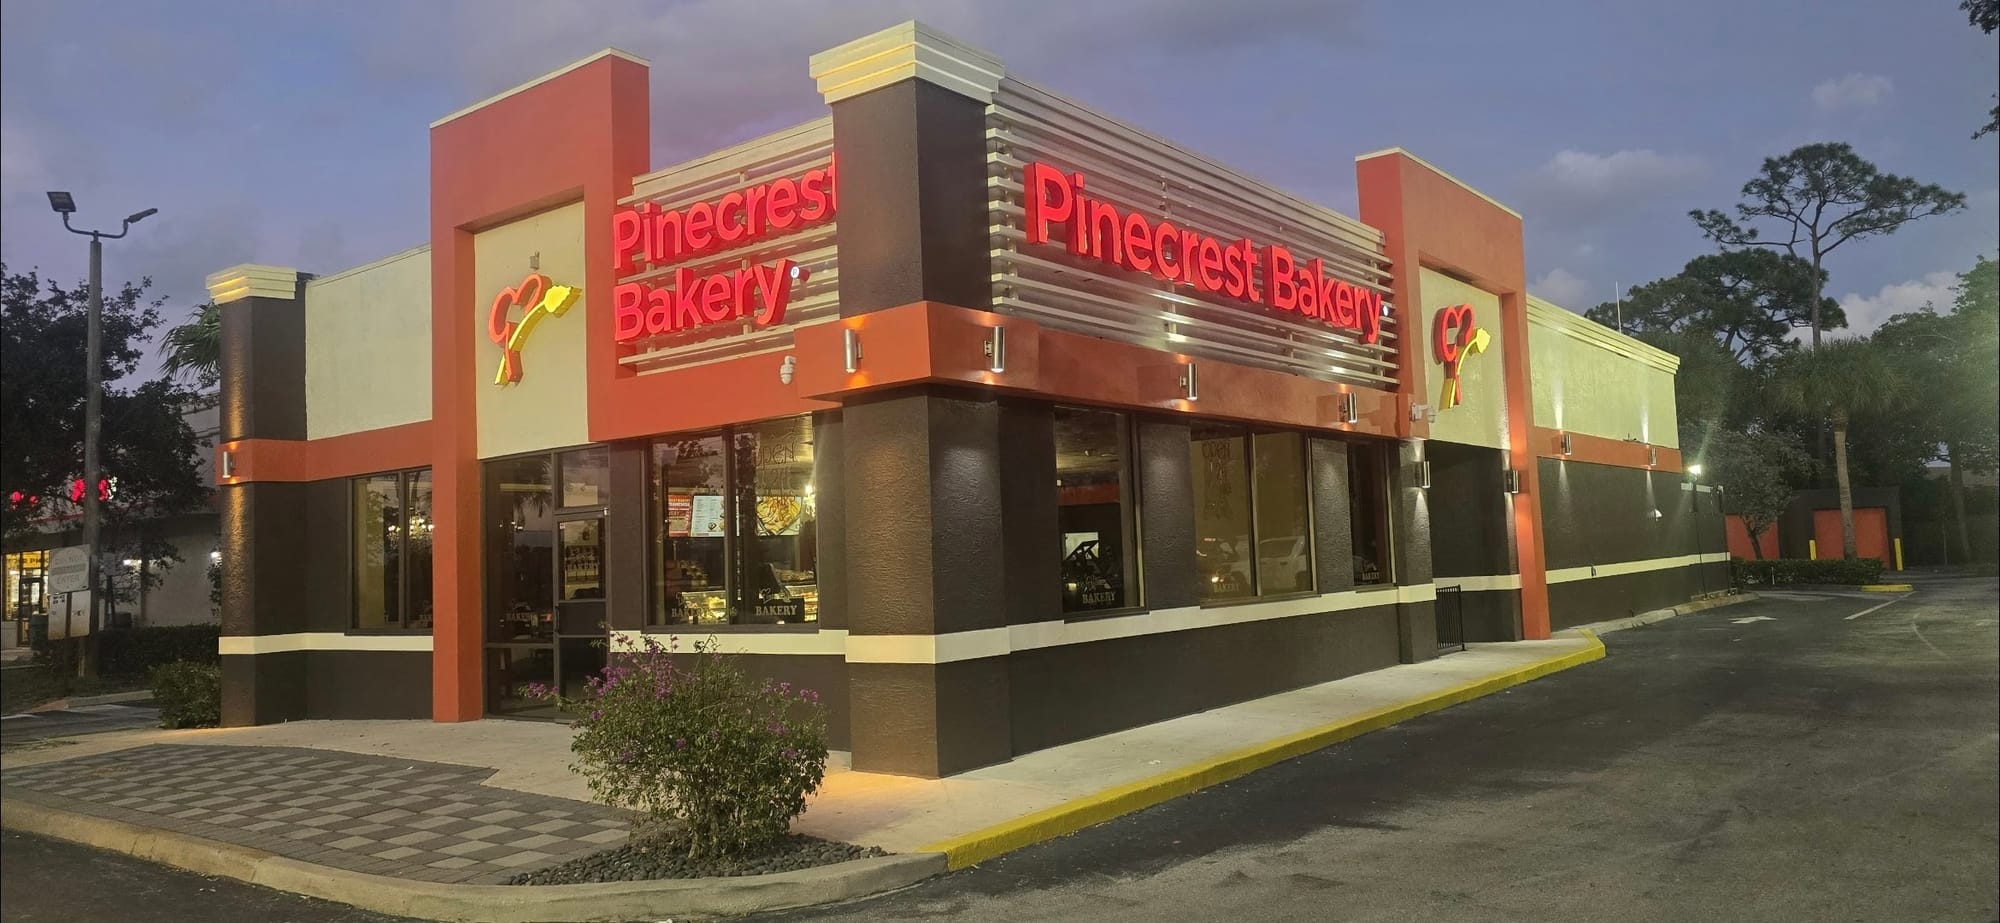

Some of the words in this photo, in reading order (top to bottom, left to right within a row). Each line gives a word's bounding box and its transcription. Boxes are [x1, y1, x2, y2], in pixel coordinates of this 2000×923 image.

[1026, 161, 1261, 302] Pinecrest
[1266, 244, 1381, 344] Bakery
[614, 258, 791, 341] Bakery
[755, 605, 798, 616] BAKERY
[1082, 591, 1116, 604] BAKERY
